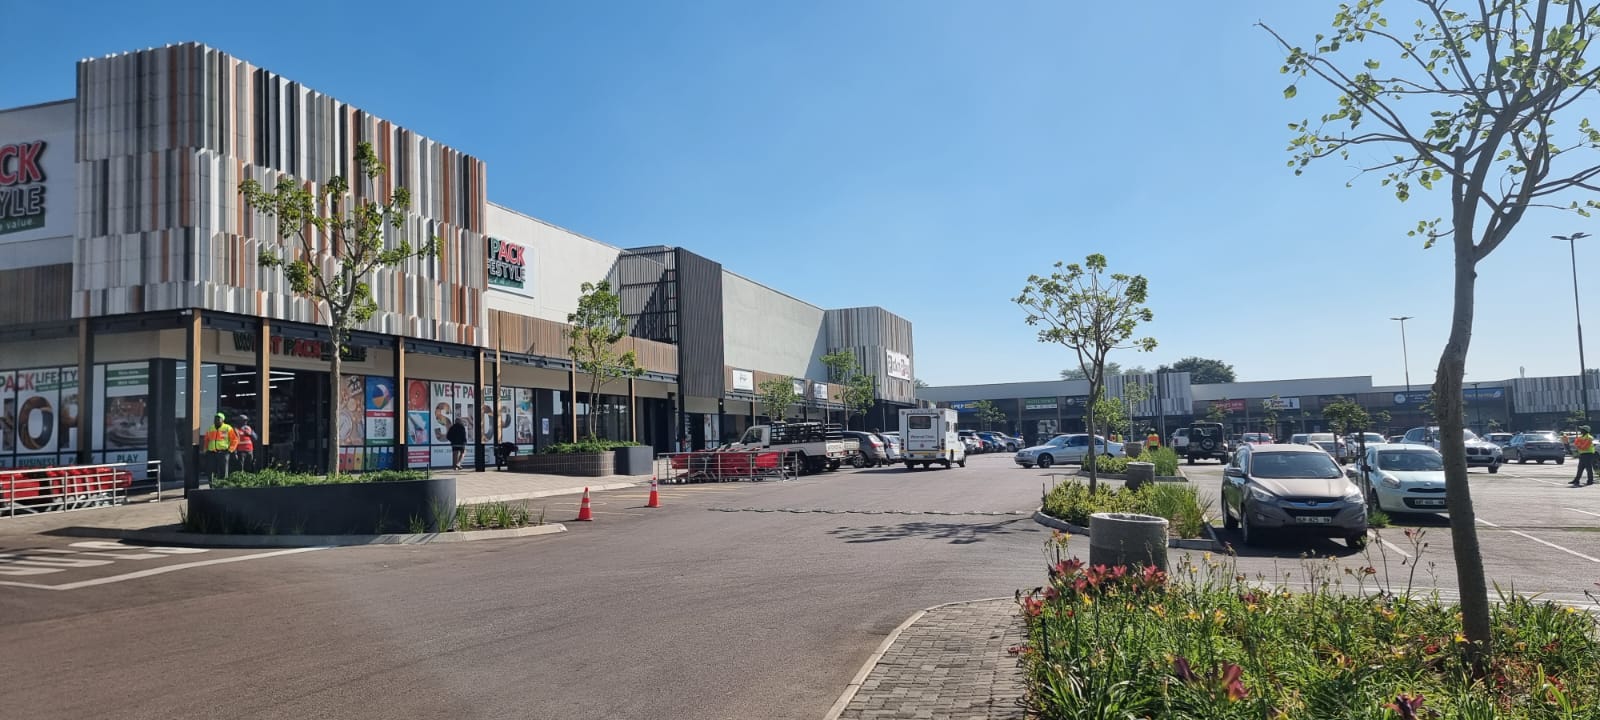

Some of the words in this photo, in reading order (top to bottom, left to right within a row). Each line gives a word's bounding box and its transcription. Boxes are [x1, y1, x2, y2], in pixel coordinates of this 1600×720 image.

[489, 238, 526, 266] PACK
[488, 259, 526, 281] ESTYLE
[233, 331, 282, 354] WT
[36, 368, 78, 384] LIFETY
[463, 386, 475, 399] PA
[484, 387, 512, 397] LIFYLE
[117, 453, 138, 463] PLAY
